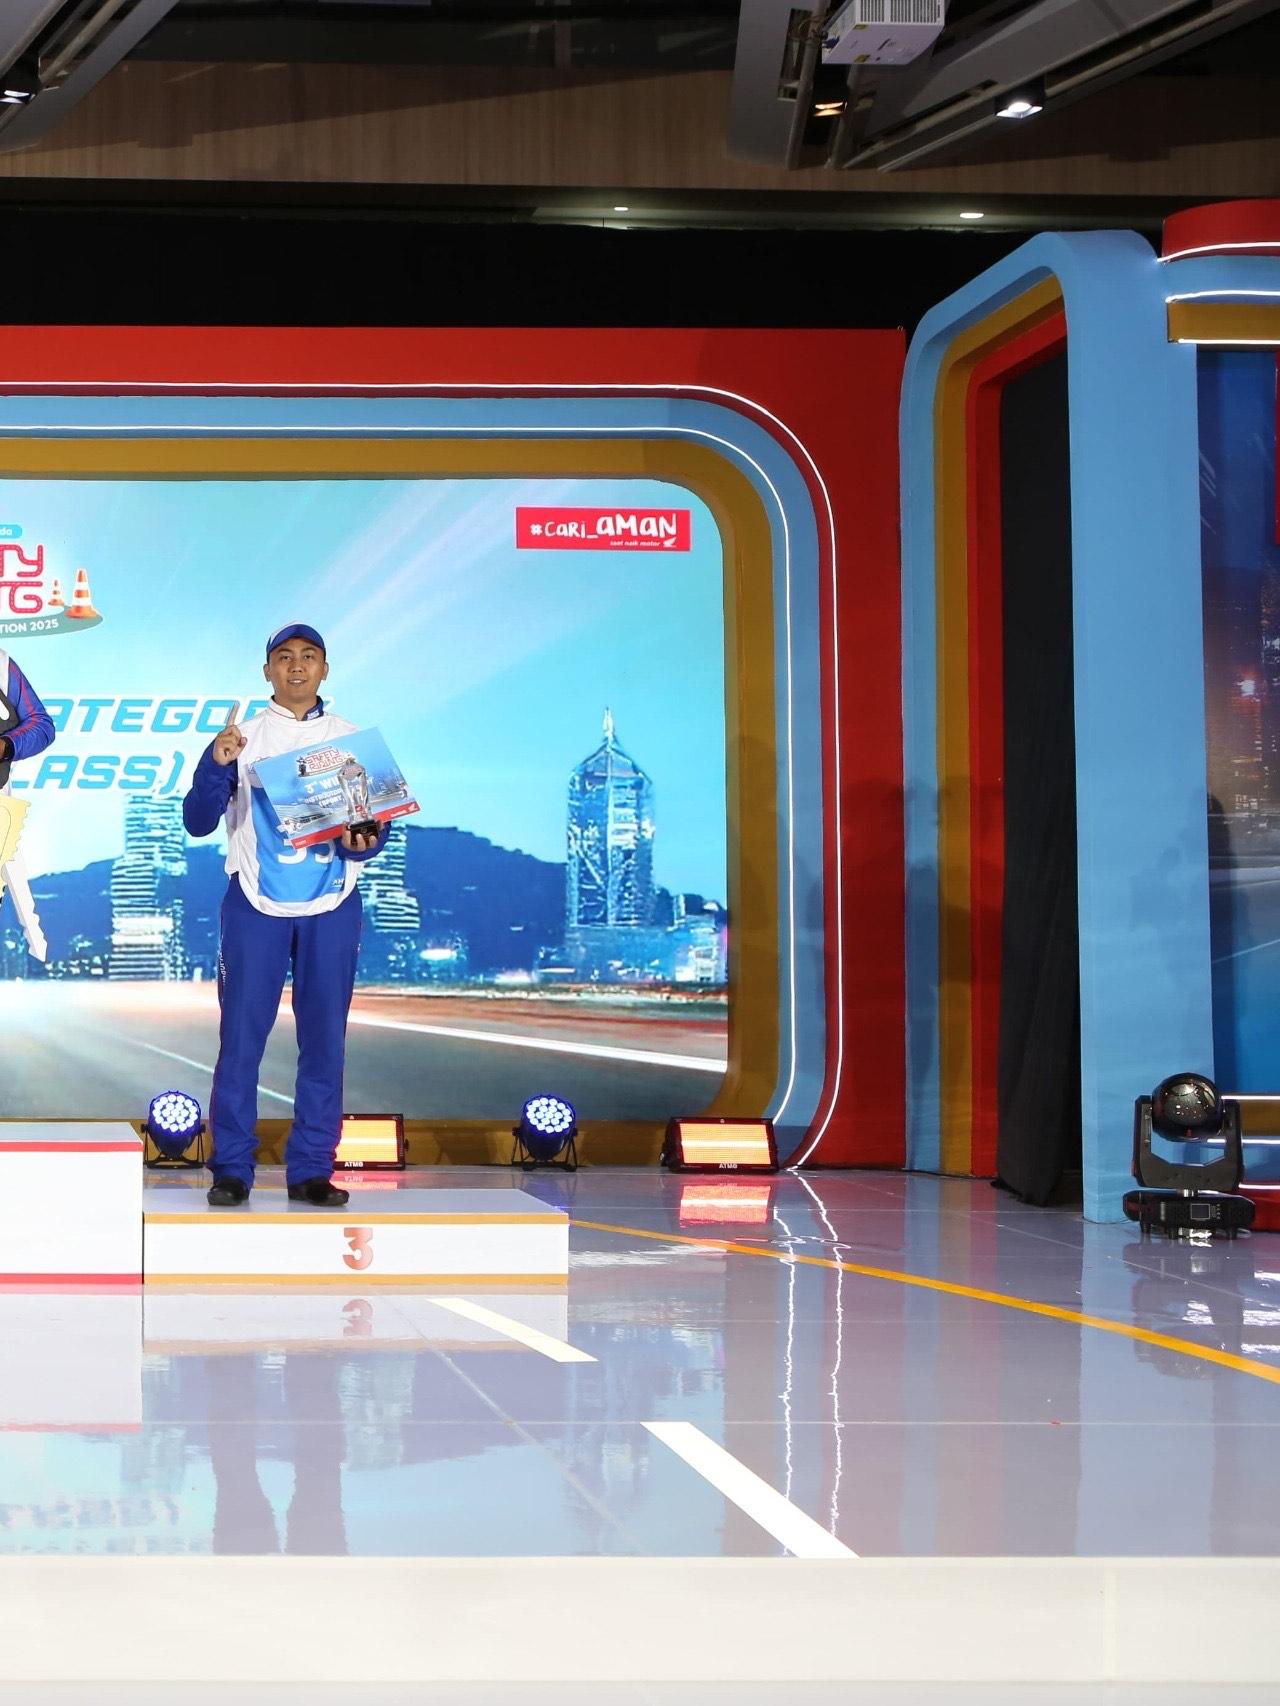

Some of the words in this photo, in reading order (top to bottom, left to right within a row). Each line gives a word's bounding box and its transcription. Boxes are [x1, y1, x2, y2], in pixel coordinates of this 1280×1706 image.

[30, 618, 59, 631] 2025
[42, 698, 329, 732] ATEGO
[11, 751, 186, 795] ASS)
[342, 1227, 373, 1270] 3
